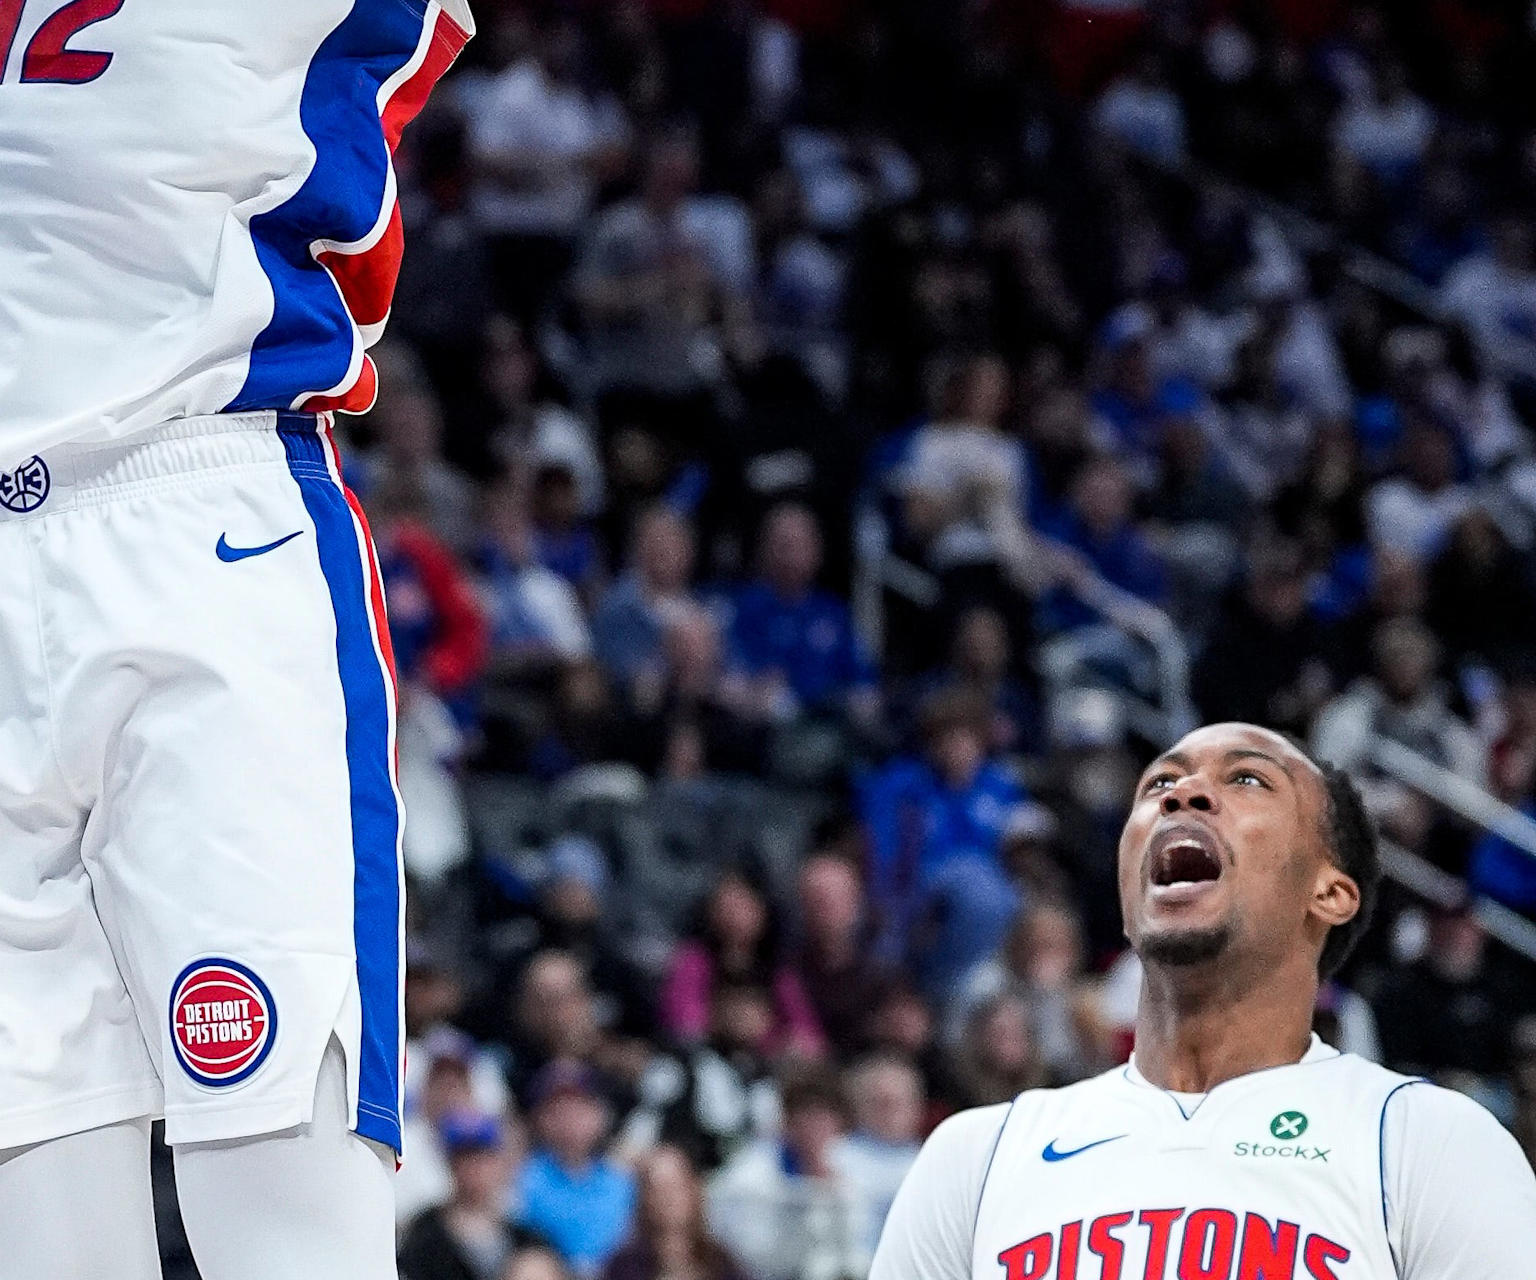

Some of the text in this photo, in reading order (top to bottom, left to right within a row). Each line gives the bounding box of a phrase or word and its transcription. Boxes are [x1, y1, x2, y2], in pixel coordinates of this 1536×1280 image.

[183, 998, 250, 1024] DETROIT
[185, 1019, 253, 1045] PISTONS
[1233, 1141, 1332, 1163] StockX
